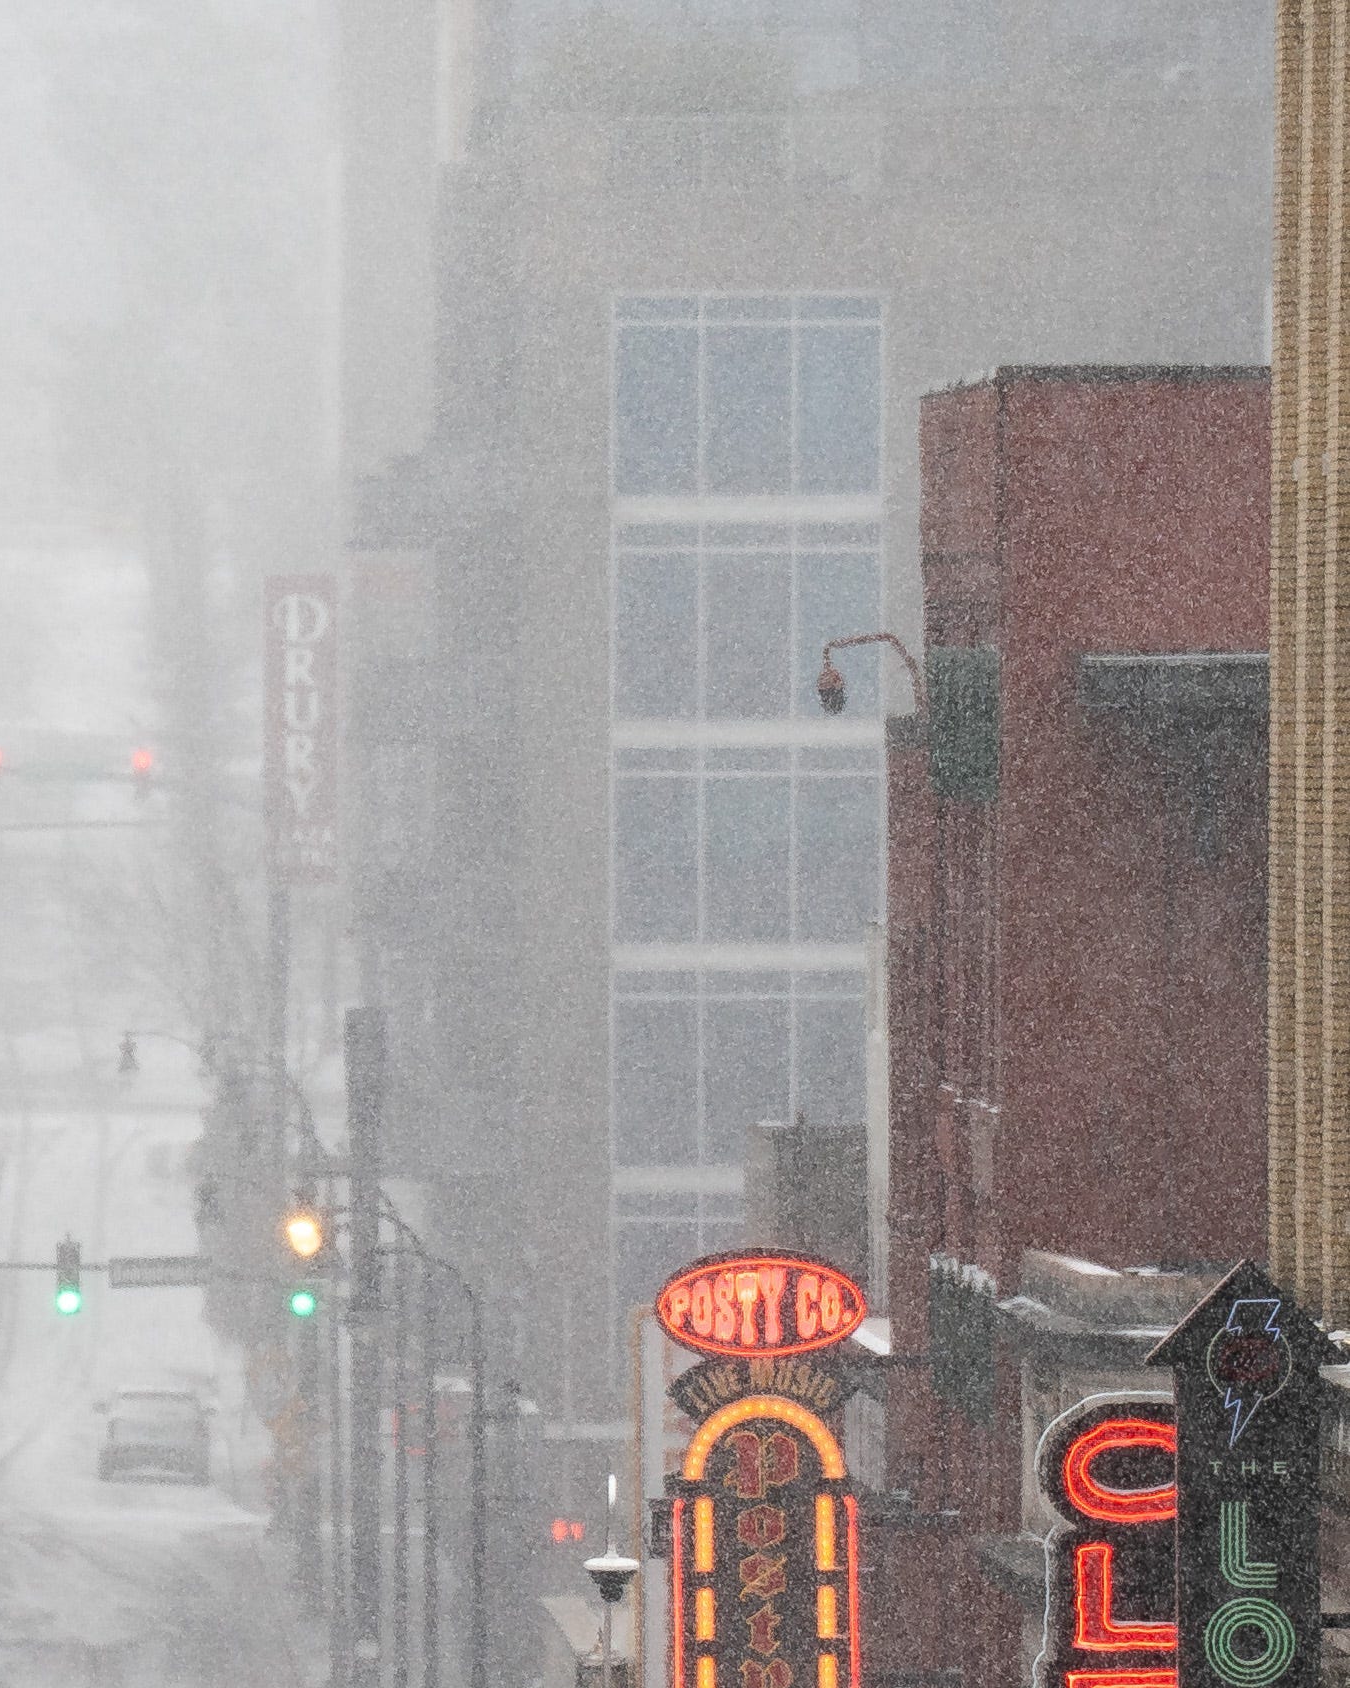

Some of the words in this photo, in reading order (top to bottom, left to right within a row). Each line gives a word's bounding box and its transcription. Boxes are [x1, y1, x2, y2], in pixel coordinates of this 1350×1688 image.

[272, 593, 330, 816] DRURY
[669, 1267, 787, 1346] POSTY
[796, 1274, 853, 1340] CO.
[1209, 1460, 1290, 1476] THE
